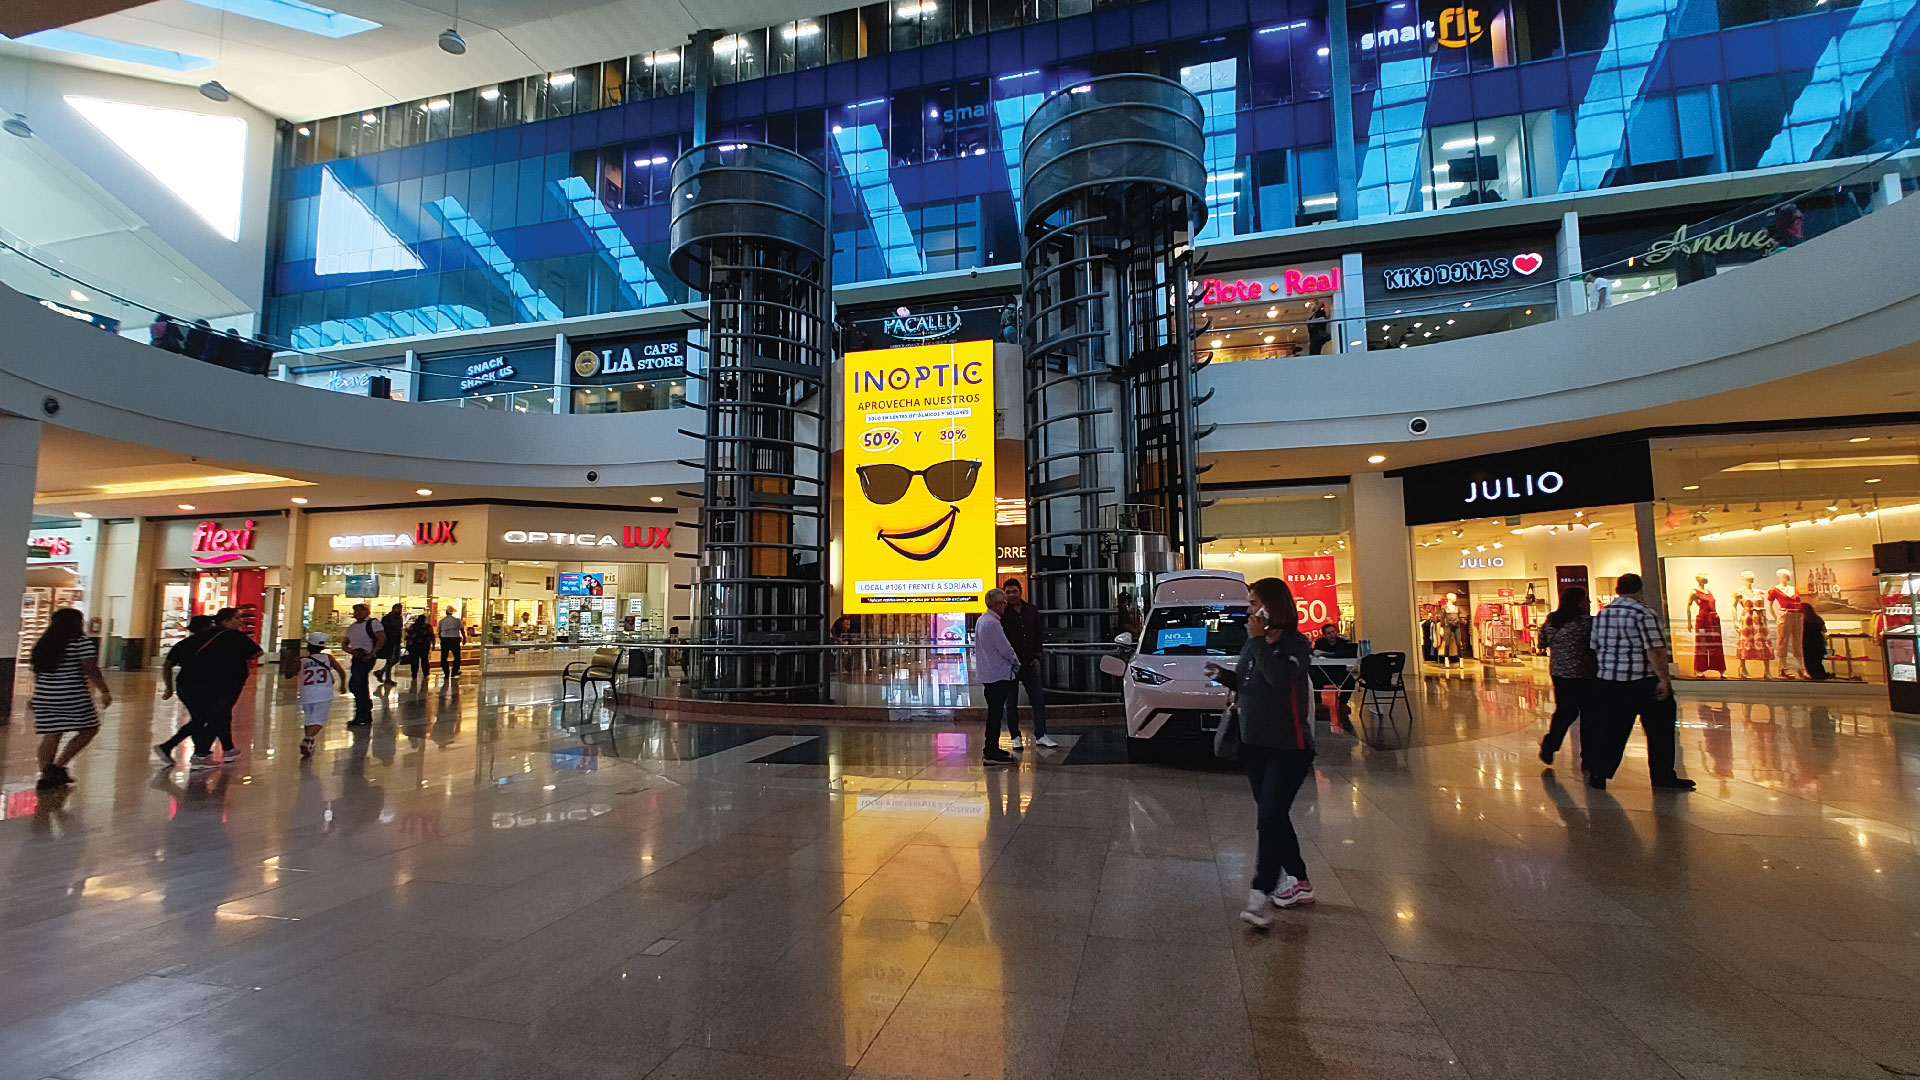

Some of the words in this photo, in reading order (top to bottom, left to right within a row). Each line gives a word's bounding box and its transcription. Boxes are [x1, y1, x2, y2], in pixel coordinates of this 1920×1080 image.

[1361, 20, 1435, 50] smart
[1439, 7, 1481, 41] fit
[1383, 266, 1435, 290] KIKO
[1435, 257, 1510, 285] DONAS
[1202, 278, 1263, 304] Elote
[1284, 267, 1340, 296] Real
[644, 342, 679, 356] CAPS
[467, 356, 504, 376] SNACK
[499, 365, 514, 377] US
[601, 348, 635, 374] LA
[637, 355, 685, 370] STORE
[854, 361, 983, 393] INOPTIC
[857, 398, 921, 411] APROVECHA
[924, 393, 980, 406] NUESTROS
[864, 431, 899, 447] 50%
[914, 431, 922, 442] Y
[940, 429, 967, 440] 30%
[1464, 471, 1564, 503] JULIO
[192, 520, 254, 551] flexi
[329, 533, 415, 548] OPTICA
[415, 521, 458, 544] LUX
[503, 530, 619, 547] OPTICA
[622, 526, 671, 548] LUX
[1459, 557, 1504, 569] JULIO
[1287, 573, 1332, 582] REBAJAS
[1812, 584, 1841, 594] JULIO
[303, 668, 328, 686] 23
